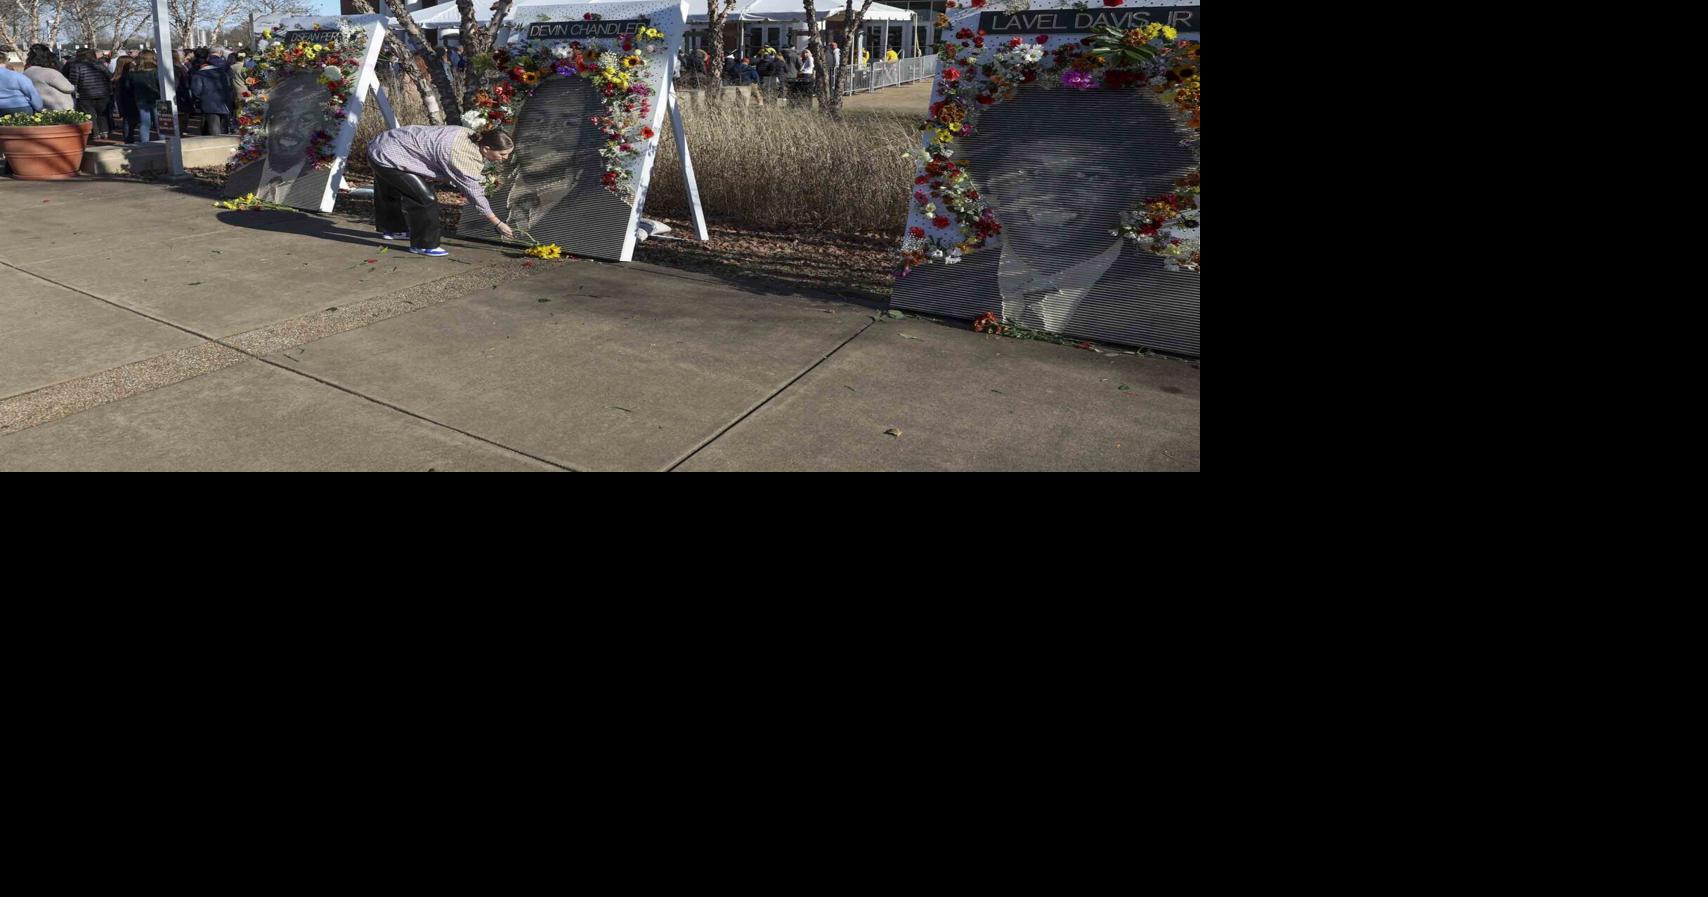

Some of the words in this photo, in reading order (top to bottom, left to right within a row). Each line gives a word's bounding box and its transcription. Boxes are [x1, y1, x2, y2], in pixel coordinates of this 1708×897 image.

[991, 13, 1067, 30] LAVEL
[1074, 11, 1151, 29] DAVIS
[530, 23, 568, 37] DEVIN
